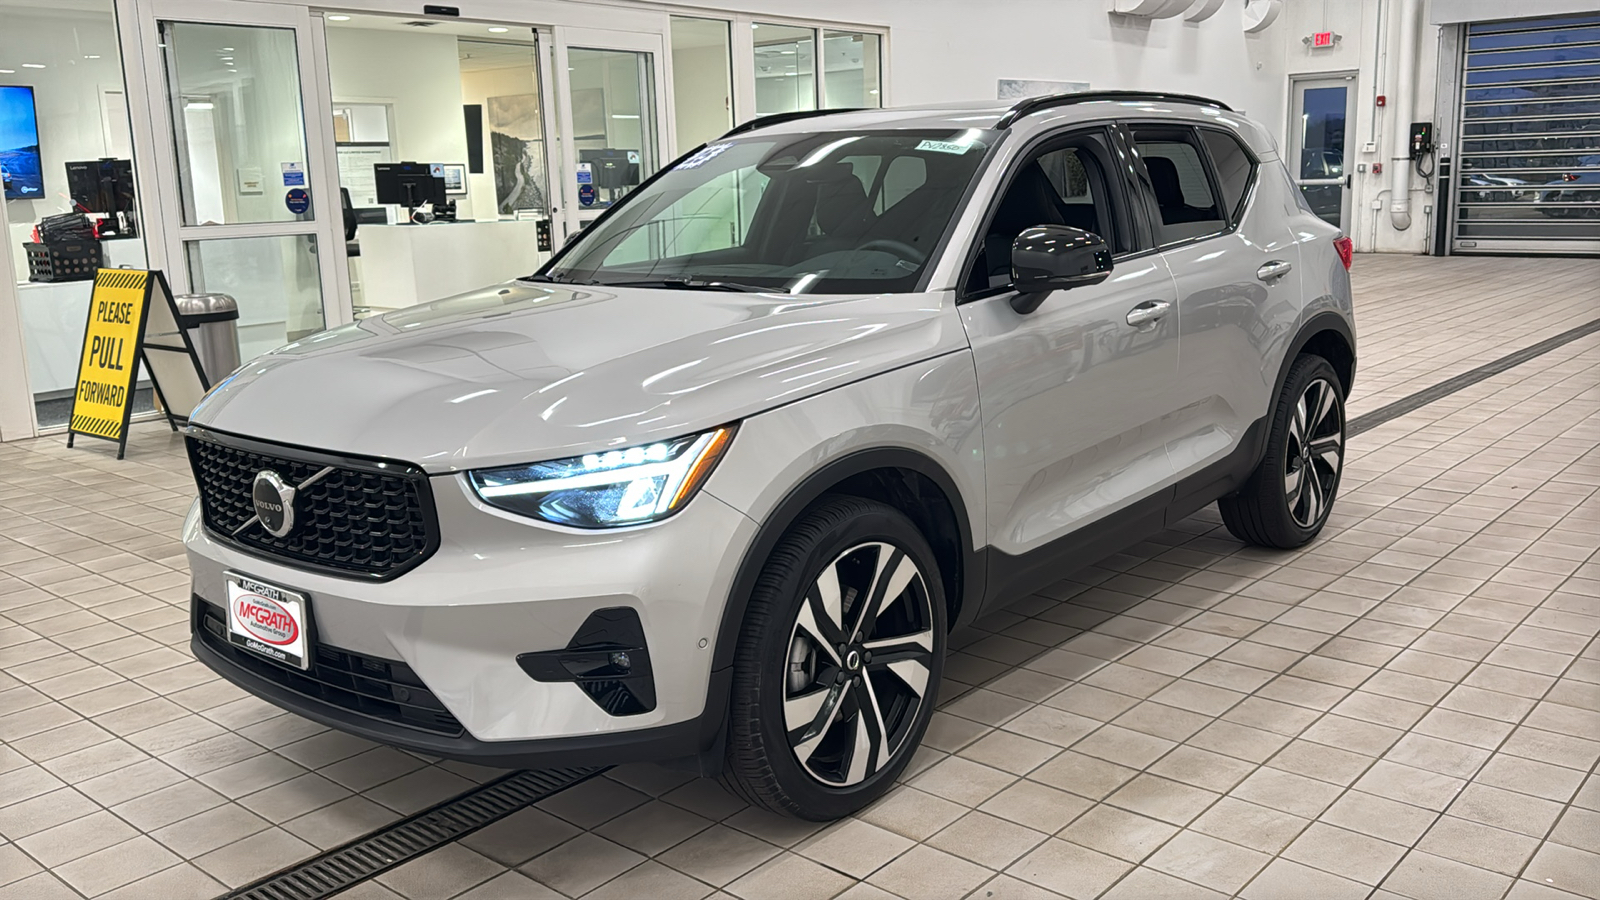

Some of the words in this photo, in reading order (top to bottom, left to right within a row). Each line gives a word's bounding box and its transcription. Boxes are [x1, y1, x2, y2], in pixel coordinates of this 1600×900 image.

[1315, 32, 1331, 46] EXIT
[96, 300, 133, 325] PLEASE
[89, 335, 124, 371] PULL
[78, 380, 125, 408] FORWARD
[255, 499, 282, 513] VOLVO
[250, 621, 273, 634] Automotive
[272, 627, 286, 639] Group
